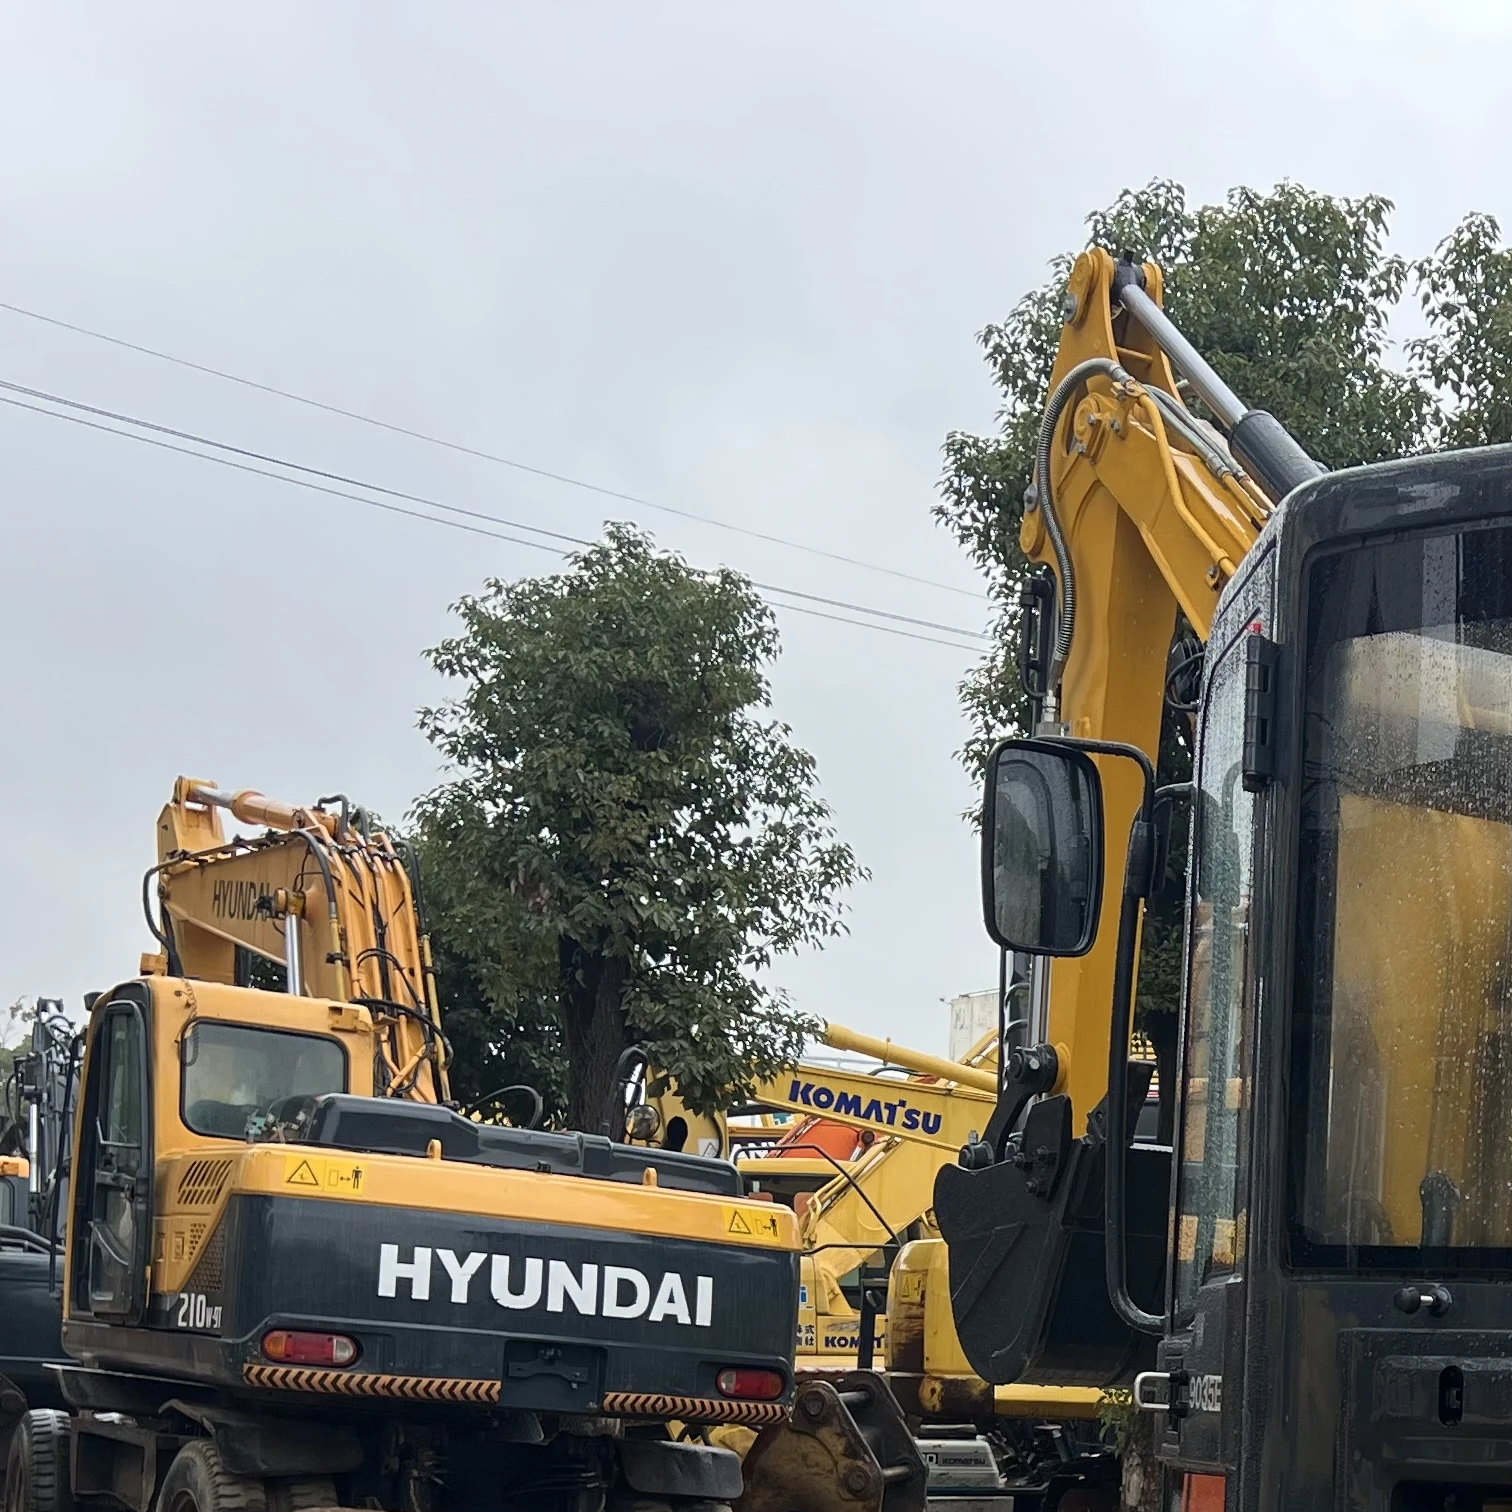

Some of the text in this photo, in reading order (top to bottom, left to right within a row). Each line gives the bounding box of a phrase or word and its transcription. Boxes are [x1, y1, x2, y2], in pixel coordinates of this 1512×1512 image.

[788, 1079, 942, 1135] KOMATSU
[377, 1243, 714, 1327] HYUNDAI
[1189, 1374, 1222, 1412] 9035E
